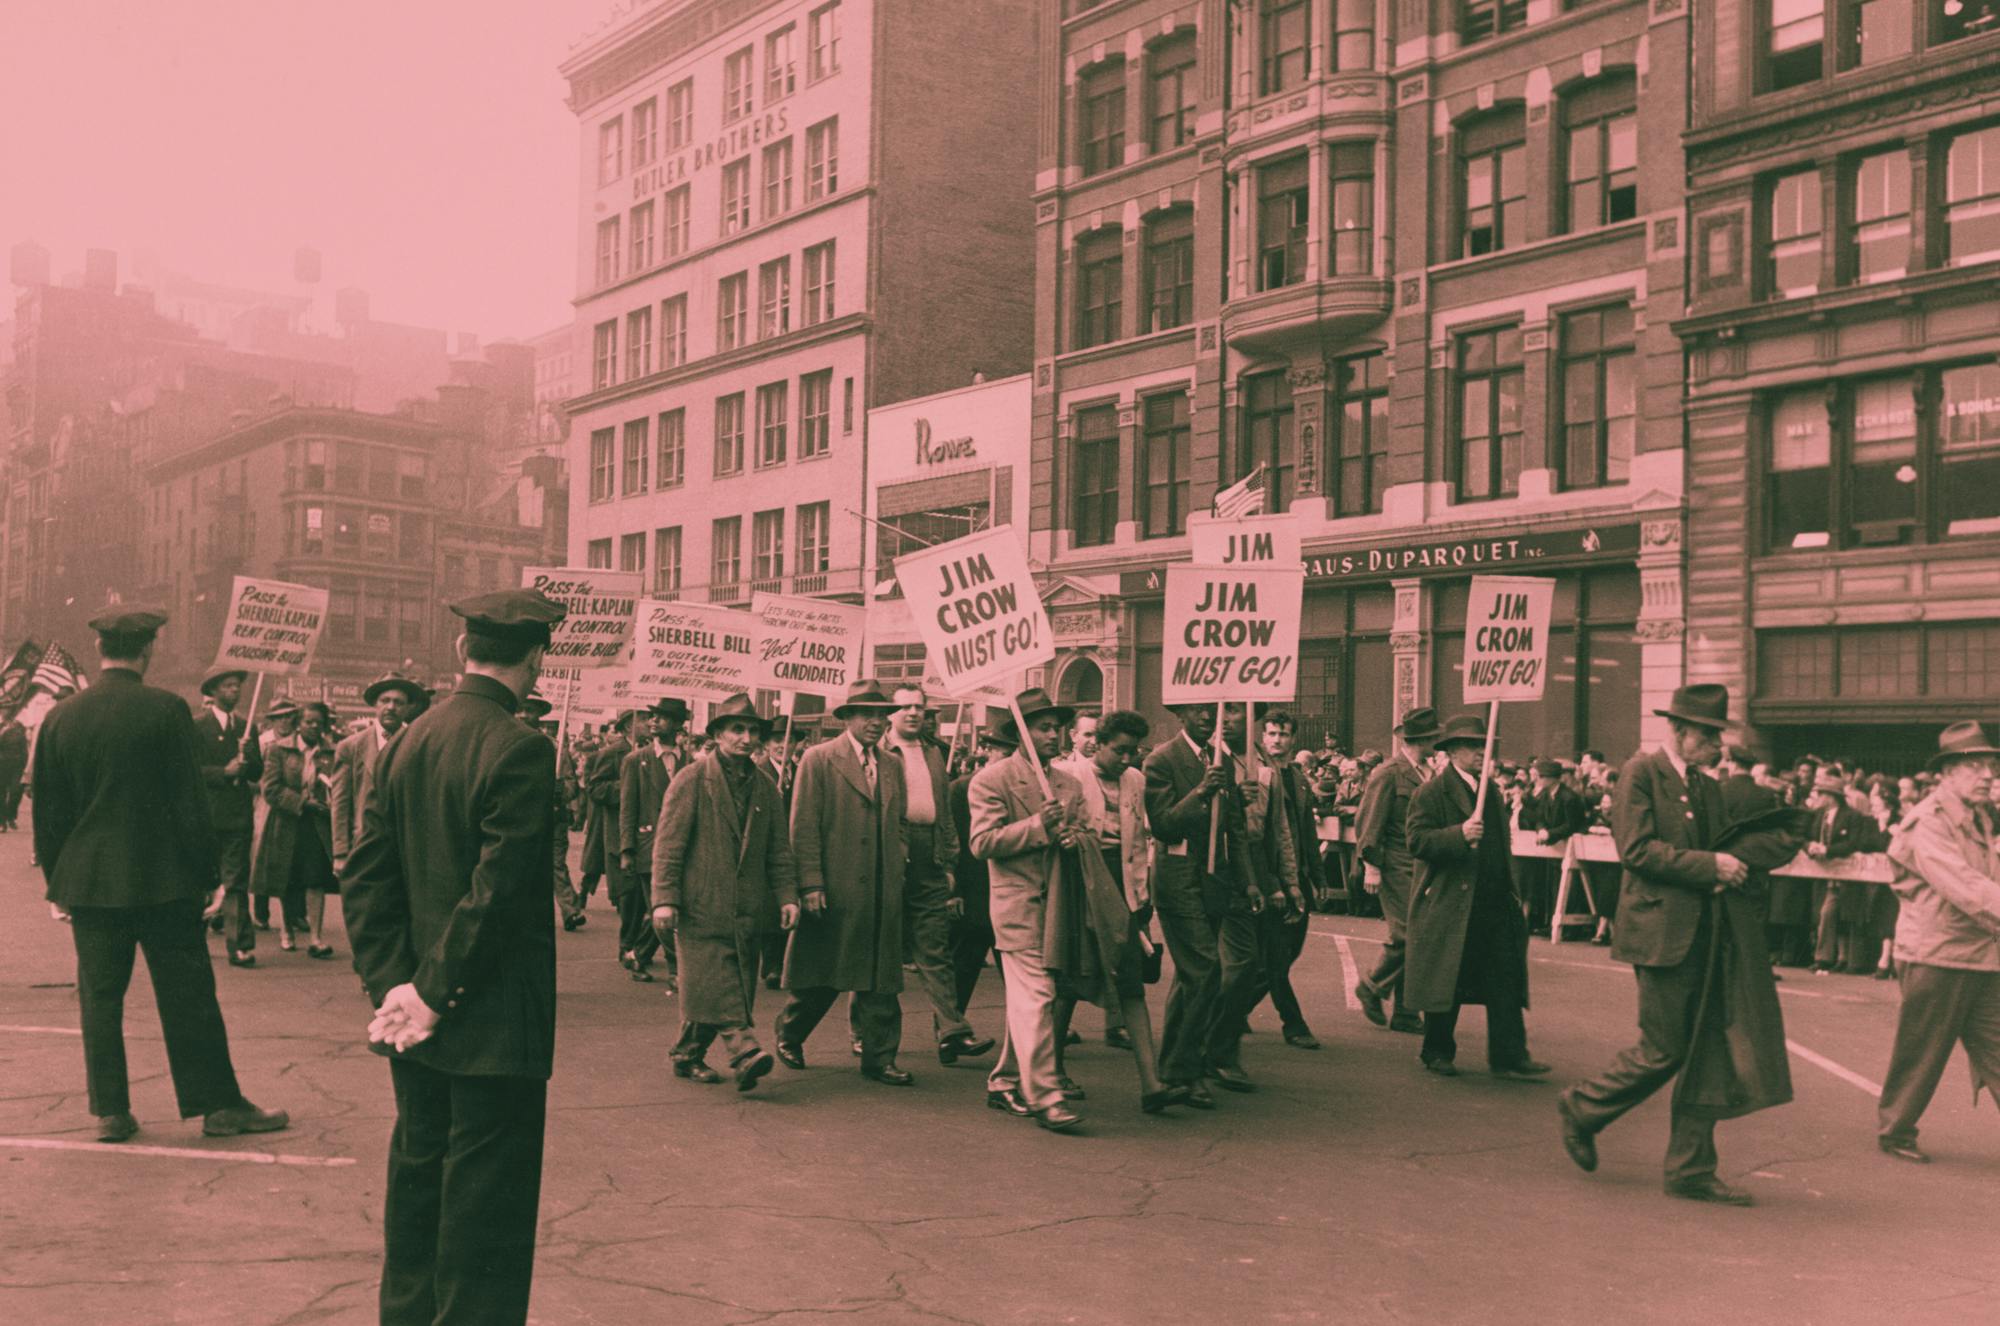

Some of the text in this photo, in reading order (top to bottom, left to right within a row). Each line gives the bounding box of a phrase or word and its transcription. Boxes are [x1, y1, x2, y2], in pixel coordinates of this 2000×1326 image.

[633, 106, 788, 201] BUTLER BROTHERS
[1222, 532, 1274, 564] JIM
[1300, 540, 1519, 577] RAUS-DUPARQUET
[939, 553, 995, 598] JIM
[937, 582, 1017, 634] CROW
[1195, 582, 1257, 613] JIM
[1488, 593, 1528, 621] JIM
[233, 624, 311, 646] RENT CONTROL
[570, 621, 627, 635] CONTROL
[648, 626, 717, 650] SHERBELL
[724, 634, 752, 655] BILL
[1184, 619, 1276, 649] CROW
[545, 642, 592, 657] USING
[651, 648, 722, 665] TO OUTLAW
[800, 641, 845, 665] LABOR
[944, 611, 1039, 678] MUST GO!
[774, 661, 846, 687] CANDIDATES
[1172, 655, 1292, 688] MUST GO!
[1509, 658, 1542, 688] GO!
